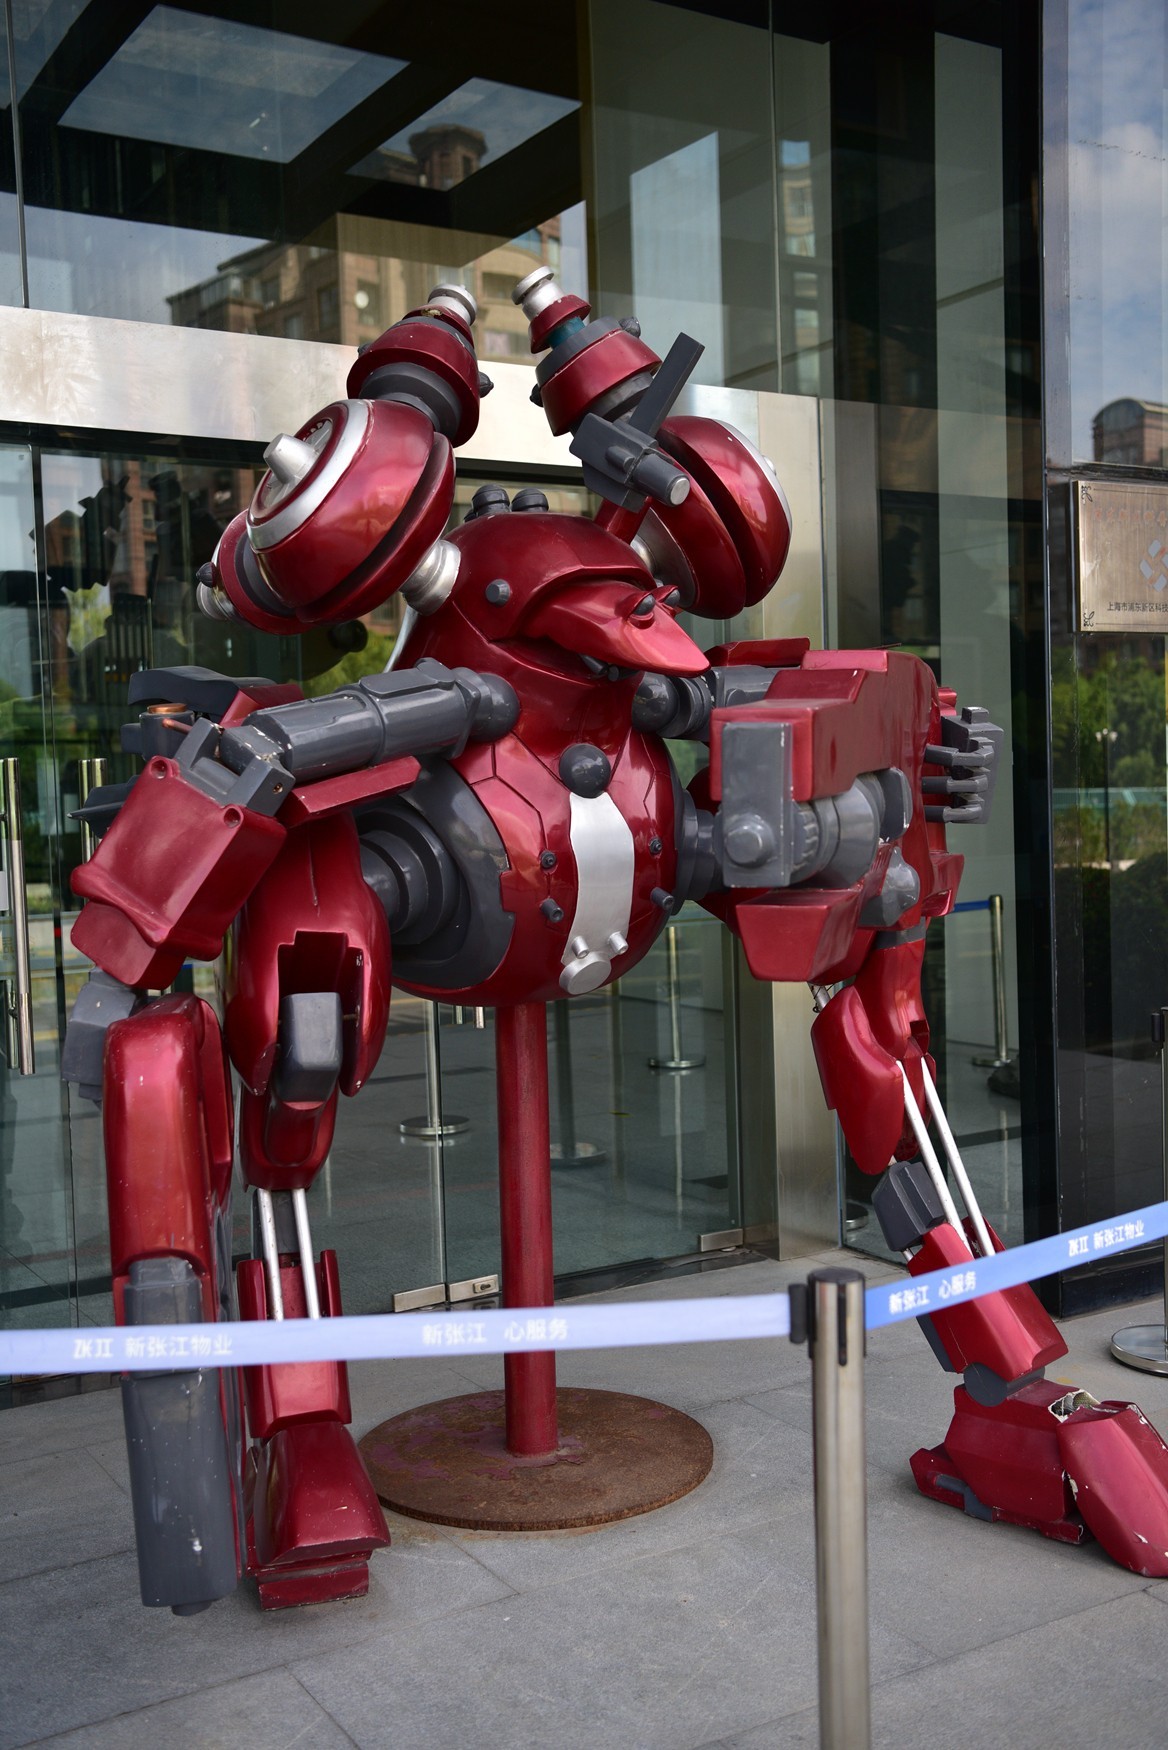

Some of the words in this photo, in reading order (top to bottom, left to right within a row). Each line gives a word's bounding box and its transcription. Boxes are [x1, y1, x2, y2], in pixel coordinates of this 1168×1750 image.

[1093, 1220, 1145, 1250] 新张江物业
[889, 1285, 930, 1314] 新张江
[938, 1271, 976, 1299] 心服务
[422, 1322, 487, 1345] 新张江
[504, 1318, 568, 1343] 心服务
[125, 1334, 233, 1358] 新张江物业
